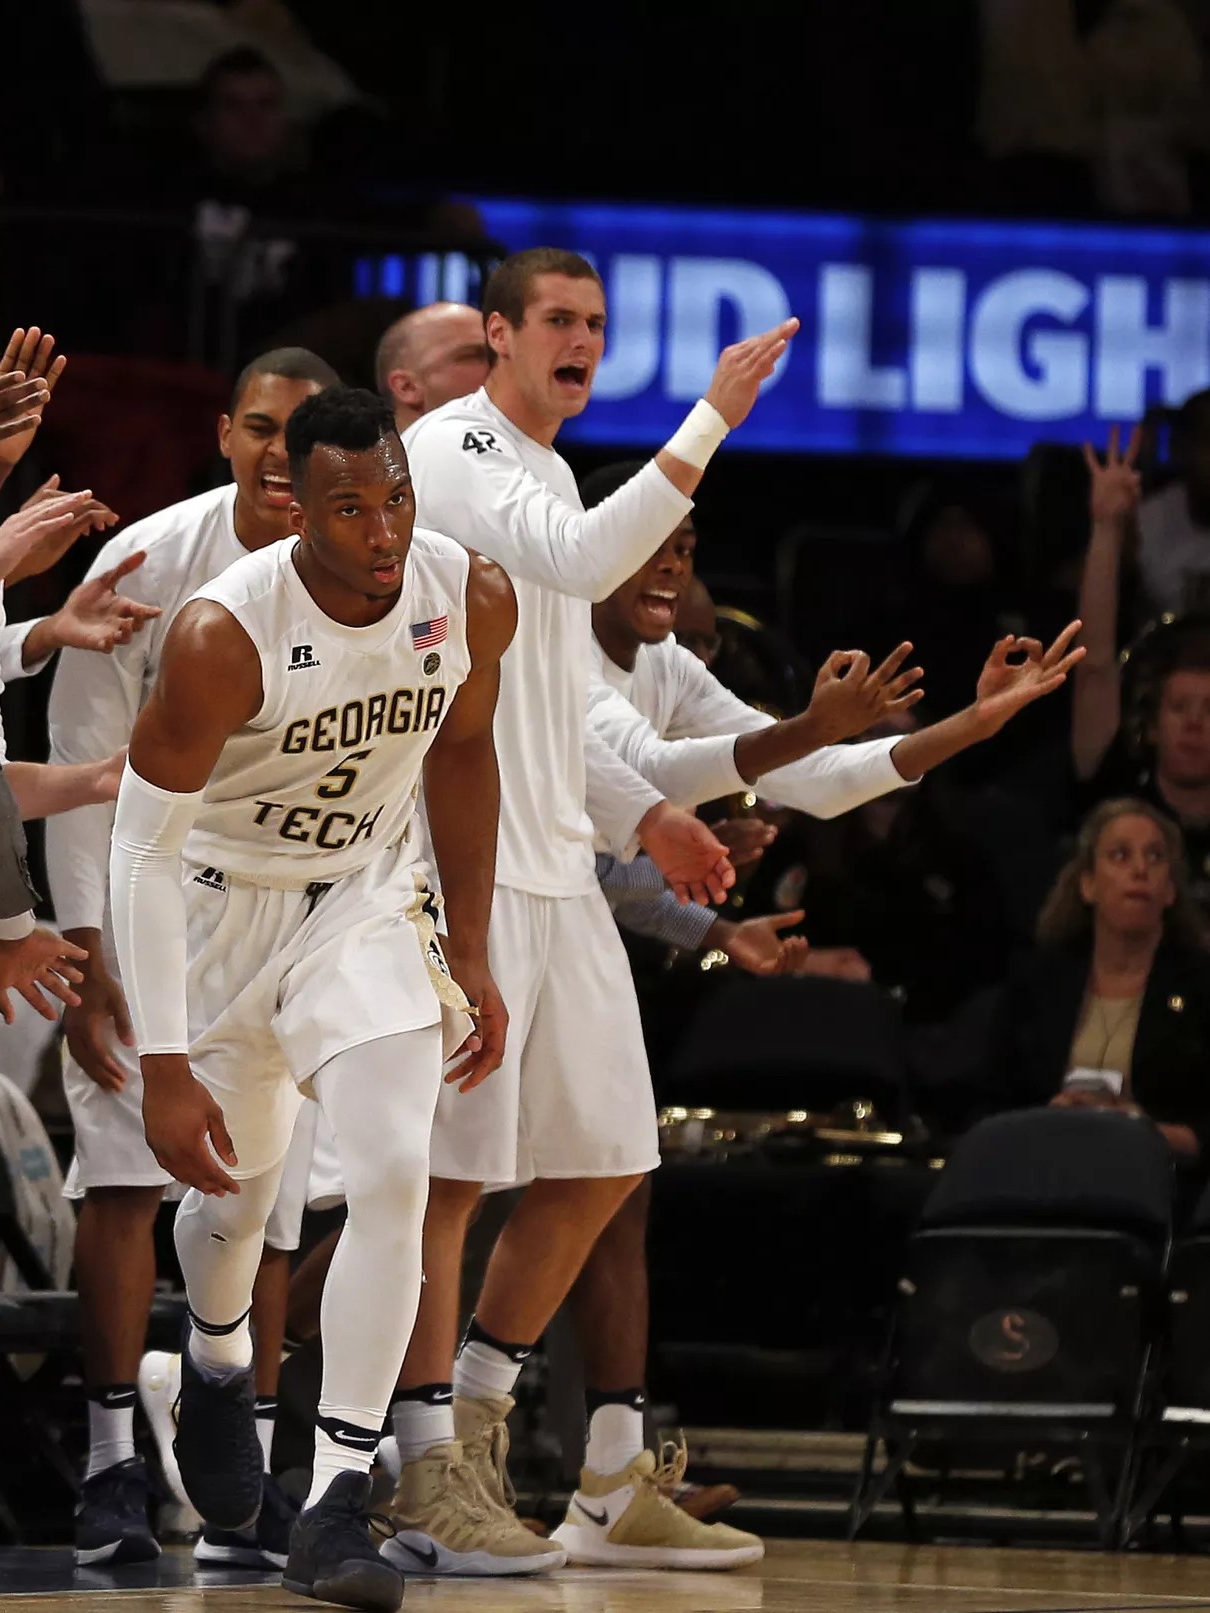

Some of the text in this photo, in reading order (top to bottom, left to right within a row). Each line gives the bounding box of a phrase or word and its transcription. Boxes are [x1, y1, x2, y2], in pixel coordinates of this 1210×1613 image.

[417, 251, 792, 402] UD
[462, 431, 503, 455] 42
[287, 660, 322, 672] RUSSELL
[280, 686, 448, 755] GEORGIA
[315, 747, 376, 800] 5
[252, 799, 386, 851] TECH
